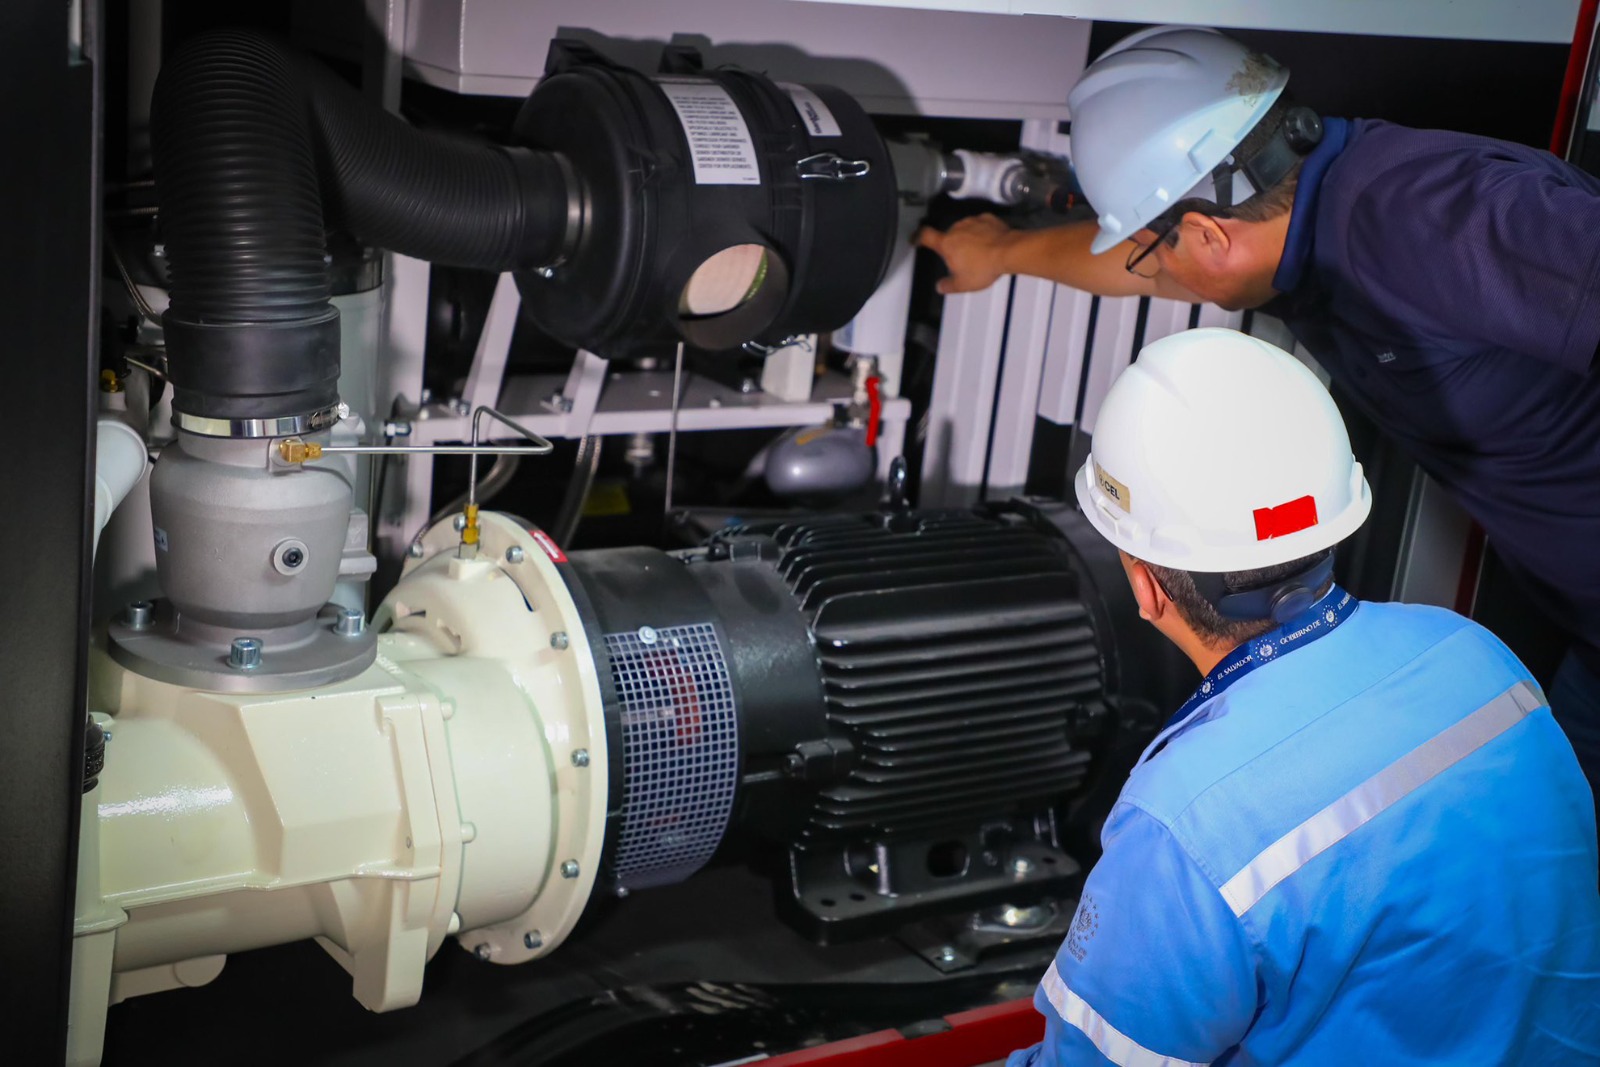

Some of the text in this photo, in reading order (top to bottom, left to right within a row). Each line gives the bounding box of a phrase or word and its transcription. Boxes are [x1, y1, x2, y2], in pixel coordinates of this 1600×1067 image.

[1105, 481, 1120, 500] CEL
[1280, 619, 1321, 645] GOBIERNO DE
[1217, 655, 1253, 680] EL SALVADOR
